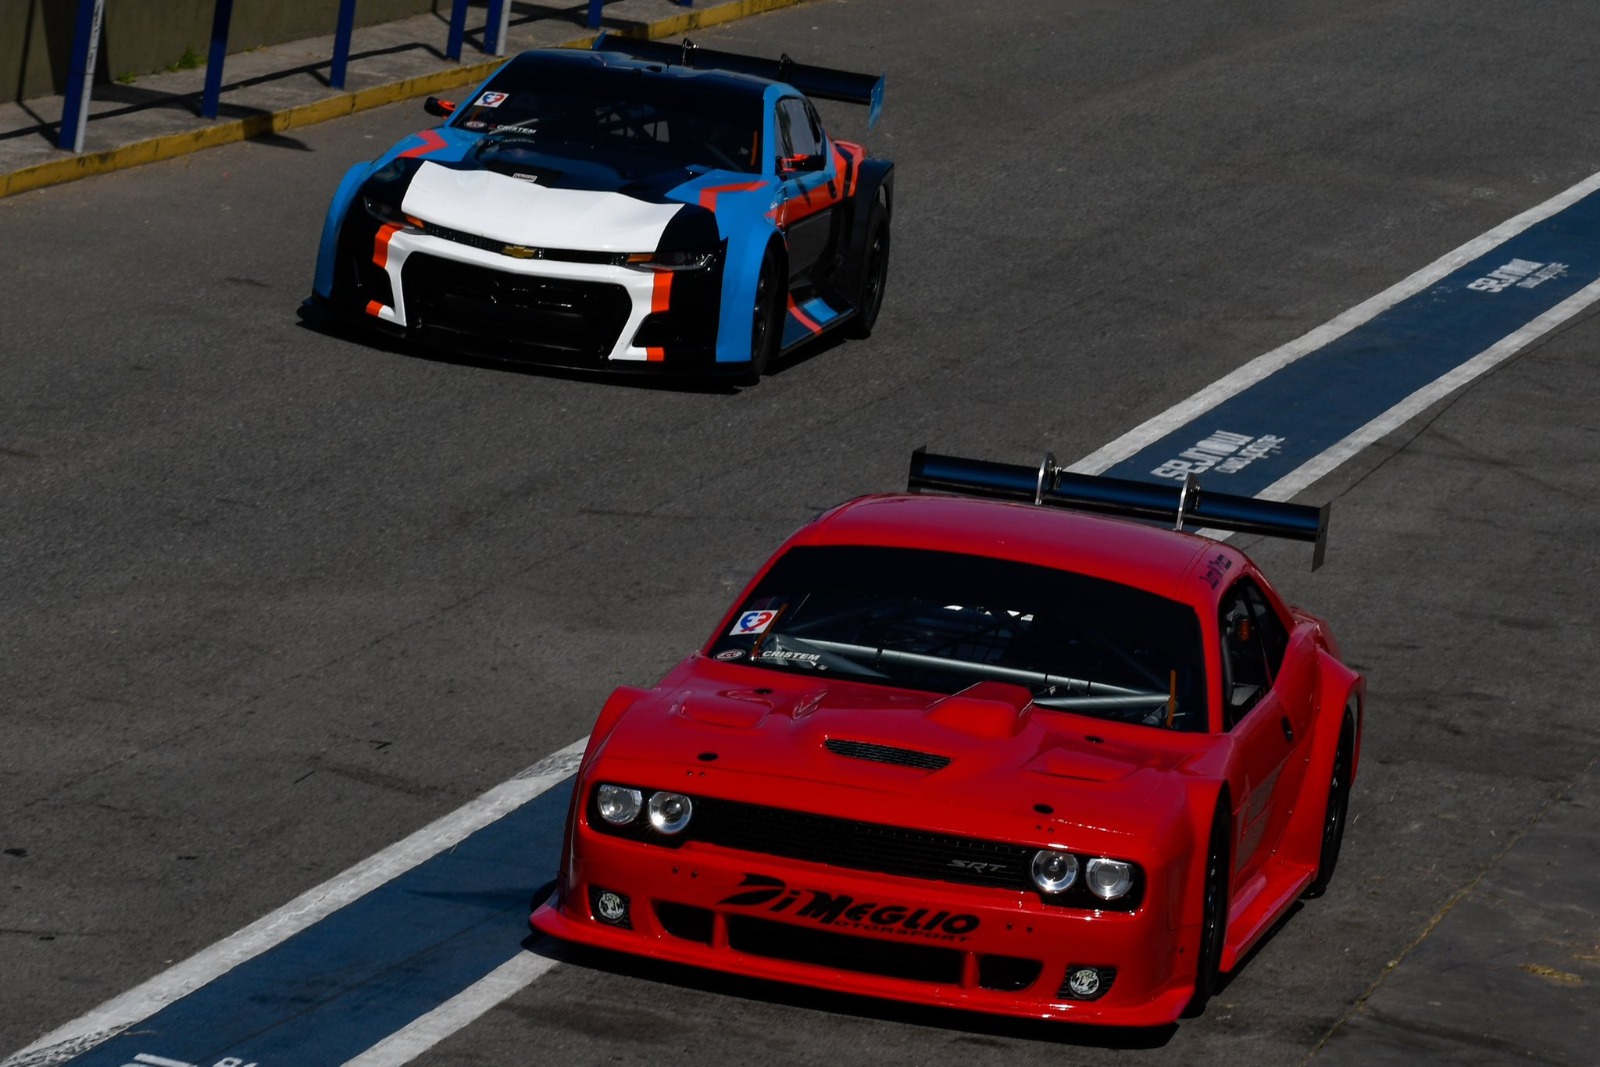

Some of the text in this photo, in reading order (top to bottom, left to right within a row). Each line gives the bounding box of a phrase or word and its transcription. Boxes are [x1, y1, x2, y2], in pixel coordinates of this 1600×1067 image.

[496, 124, 538, 135] CRISTEM
[762, 650, 821, 661] CRISTEM
[946, 859, 1008, 874] SRT
